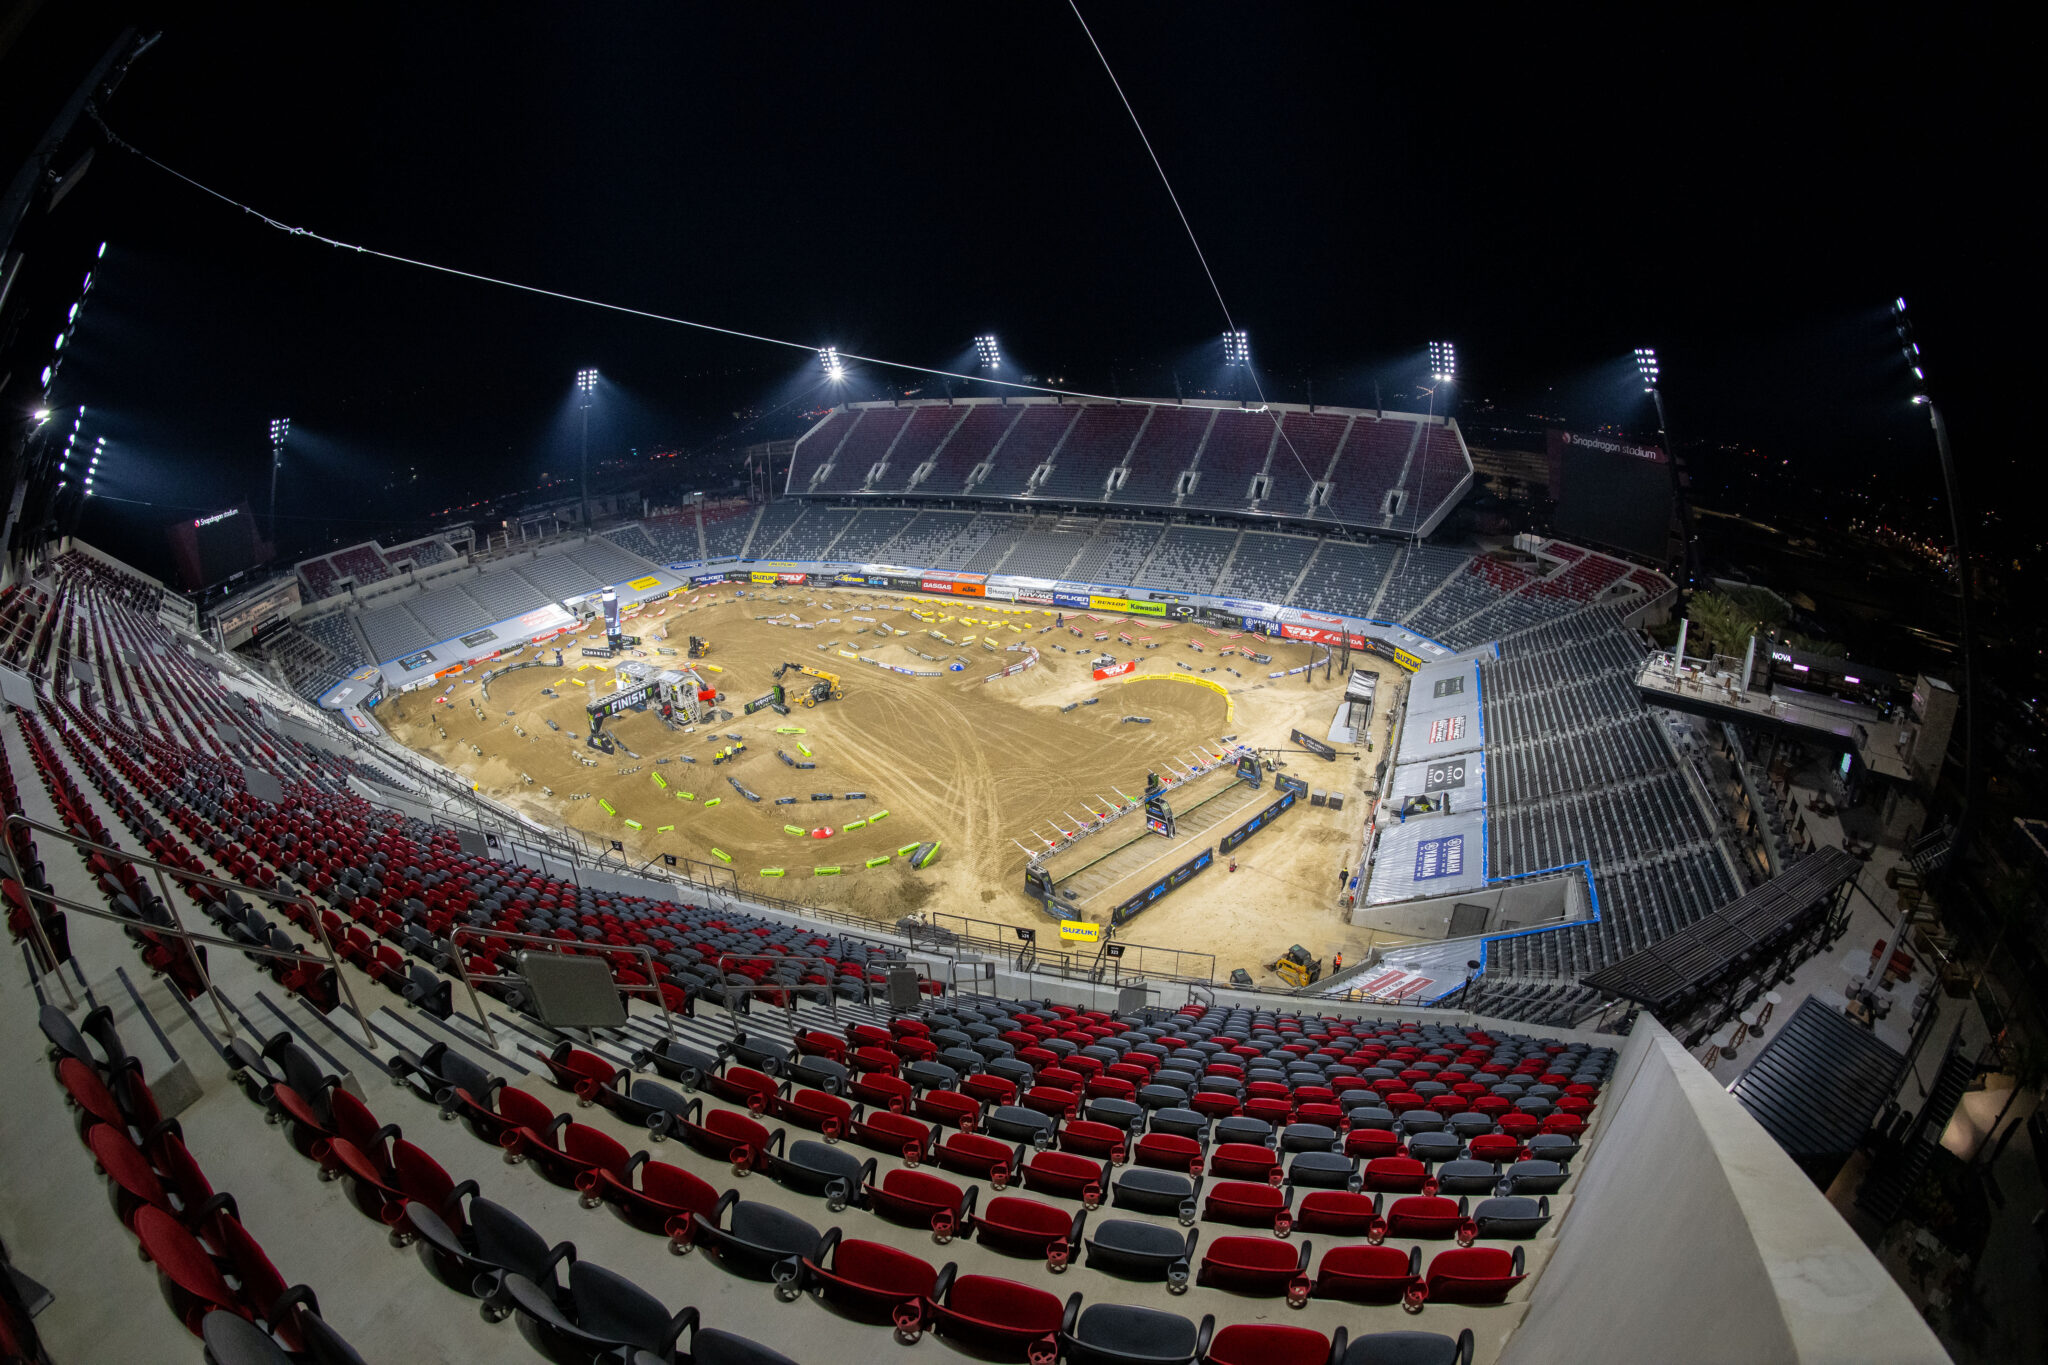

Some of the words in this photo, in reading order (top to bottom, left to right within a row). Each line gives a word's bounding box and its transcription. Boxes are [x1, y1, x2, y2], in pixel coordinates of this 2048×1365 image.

[1572, 434, 1621, 453] Snapdragon
[1622, 446, 1656, 459] stadium
[200, 513, 224, 526] Snapdragon
[753, 574, 776, 582] SUZUKI
[923, 582, 952, 591] GASGAS
[1056, 593, 1089, 602] FALKEN
[1097, 599, 1124, 607] DUNLOP
[1130, 603, 1163, 612] Kawasaki
[1772, 652, 1792, 663] NOVA
[611, 689, 647, 714] FINISH
[1422, 849, 1437, 878] YAMAHA
[1446, 845, 1461, 874] YAMAHA
[1062, 927, 1097, 936] SUZUKI
